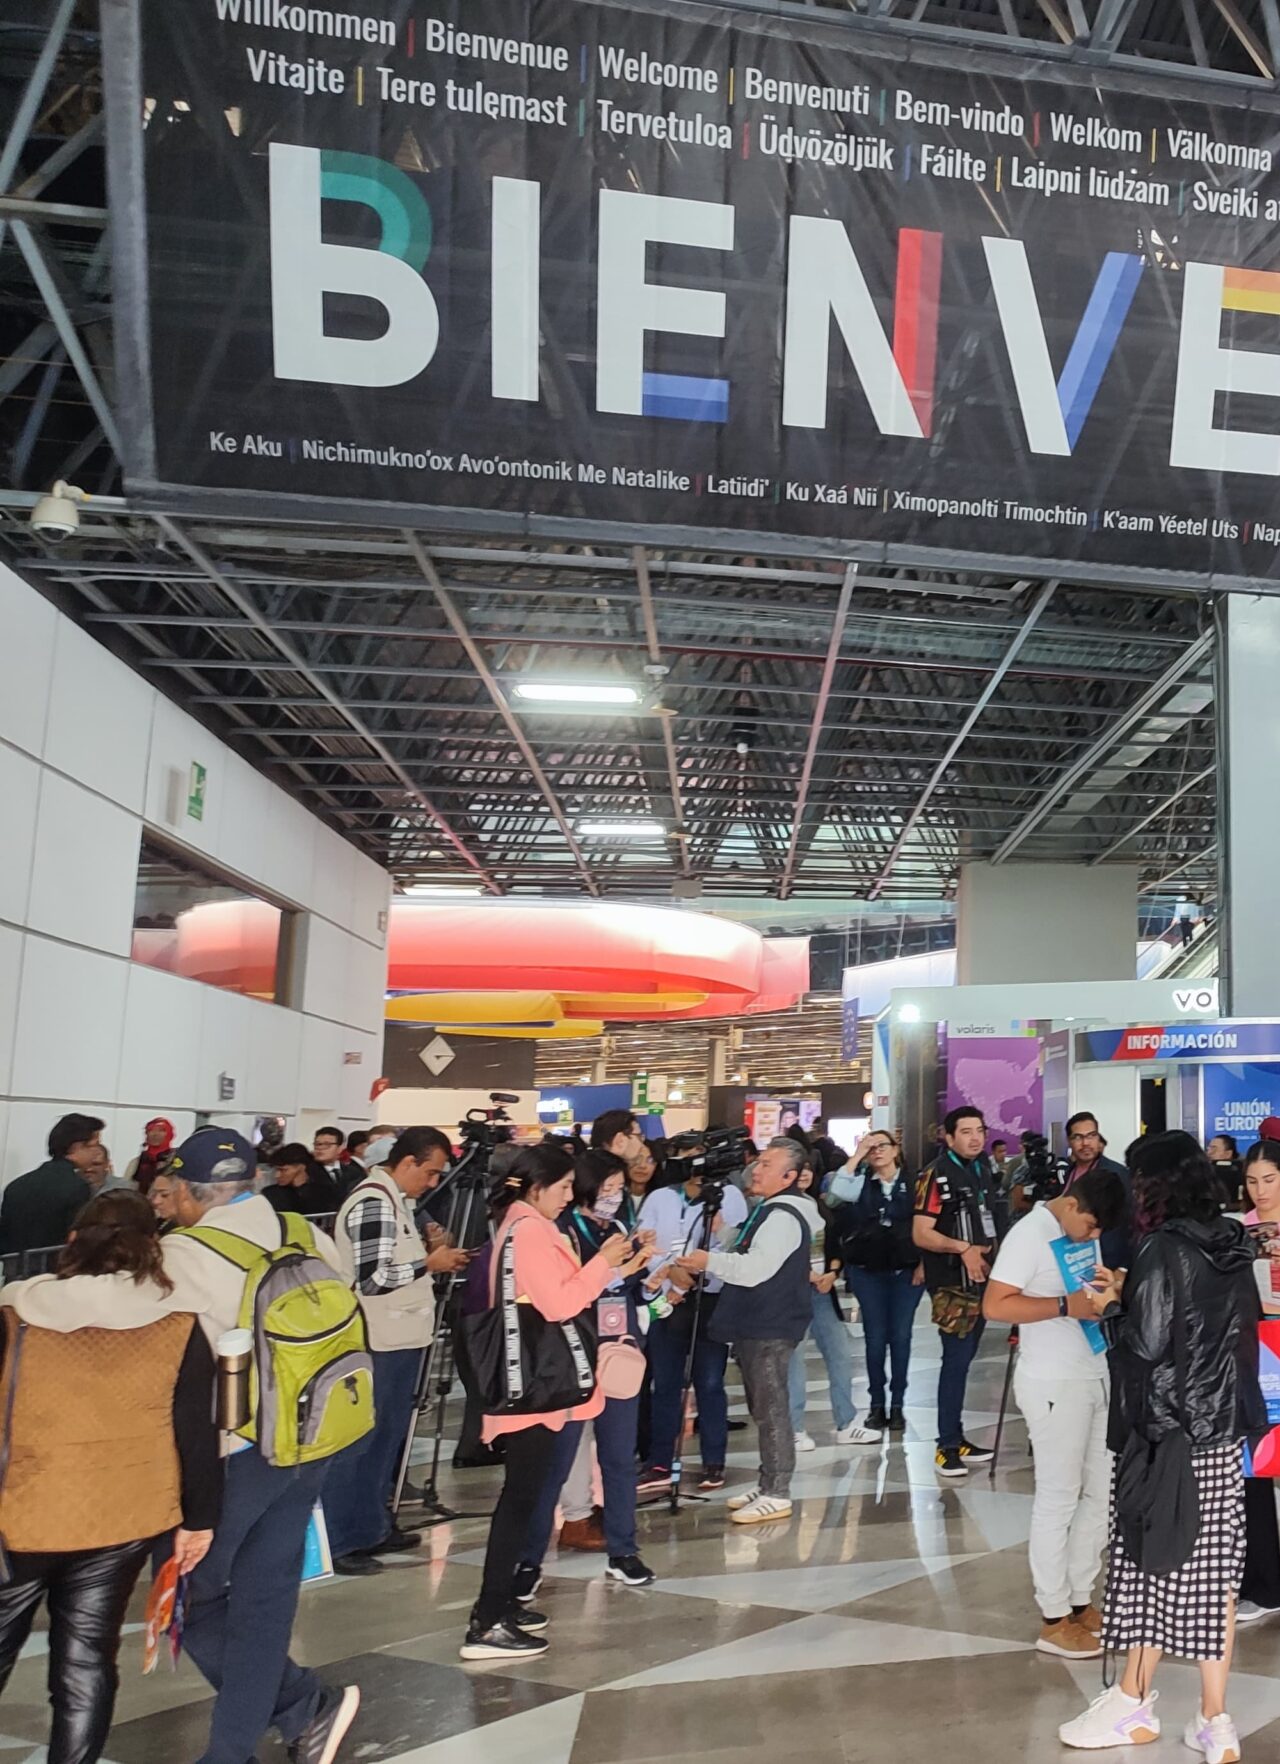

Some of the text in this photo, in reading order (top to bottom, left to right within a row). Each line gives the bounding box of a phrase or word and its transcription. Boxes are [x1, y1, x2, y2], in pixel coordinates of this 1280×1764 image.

[425, 18, 569, 72] Bienvenue
[598, 45, 718, 94] Welcome
[745, 67, 870, 115] Benvenuti
[895, 89, 1024, 137] Bem-vindo
[1050, 112, 1142, 153] Welkom
[1167, 127, 1272, 173] Välkomna
[246, 47, 345, 95] Vitajte
[376, 66, 436, 106] Tere
[596, 99, 732, 149] Tervetuloa
[920, 144, 986, 182] Fáilte
[1011, 156, 1081, 196] Laipni
[1193, 181, 1258, 219] Sveiki
[209, 431, 237, 453] Ke
[242, 435, 282, 457] Aku
[578, 463, 606, 484] Me
[612, 467, 690, 491] Natalike
[786, 482, 809, 501] Ku
[814, 484, 848, 505] Xaá
[853, 487, 877, 507] Nii
[892, 490, 999, 518] Ximopanolti
[1003, 501, 1088, 526] Timochtin
[1159, 514, 1207, 537] Yéetel
[1212, 519, 1239, 539] Uts
[1127, 1030, 1238, 1050] INFORMACIÓN
[1214, 1116, 1264, 1132] EUROP
[1223, 1098, 1271, 1116] UNIÓN
